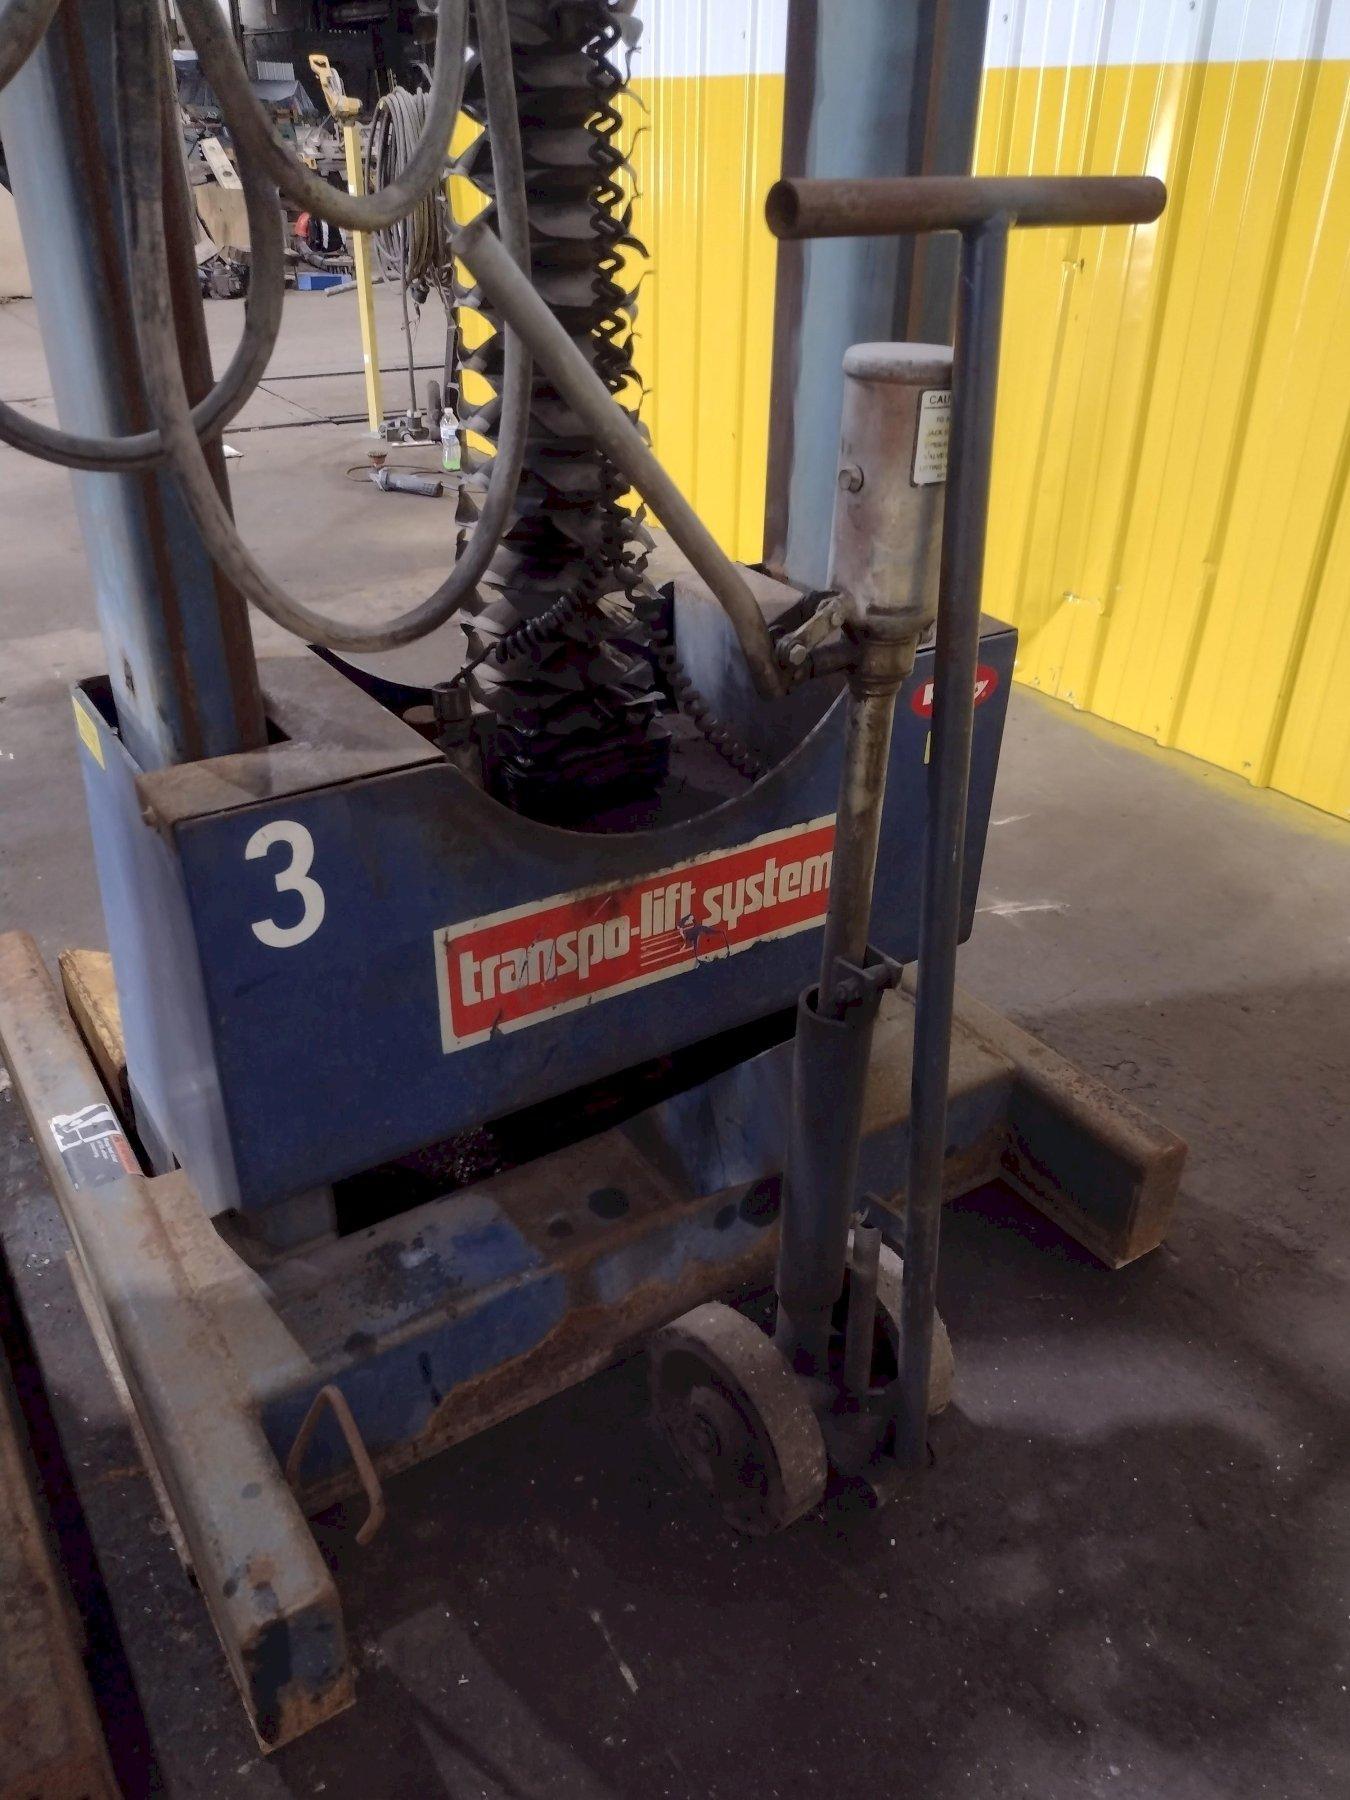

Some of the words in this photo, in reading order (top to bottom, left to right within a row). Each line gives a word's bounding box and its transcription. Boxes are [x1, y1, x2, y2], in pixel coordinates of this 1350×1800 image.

[245, 820, 325, 948] 3
[459, 880, 696, 1007] transpo-lift
[702, 850, 834, 931] system
